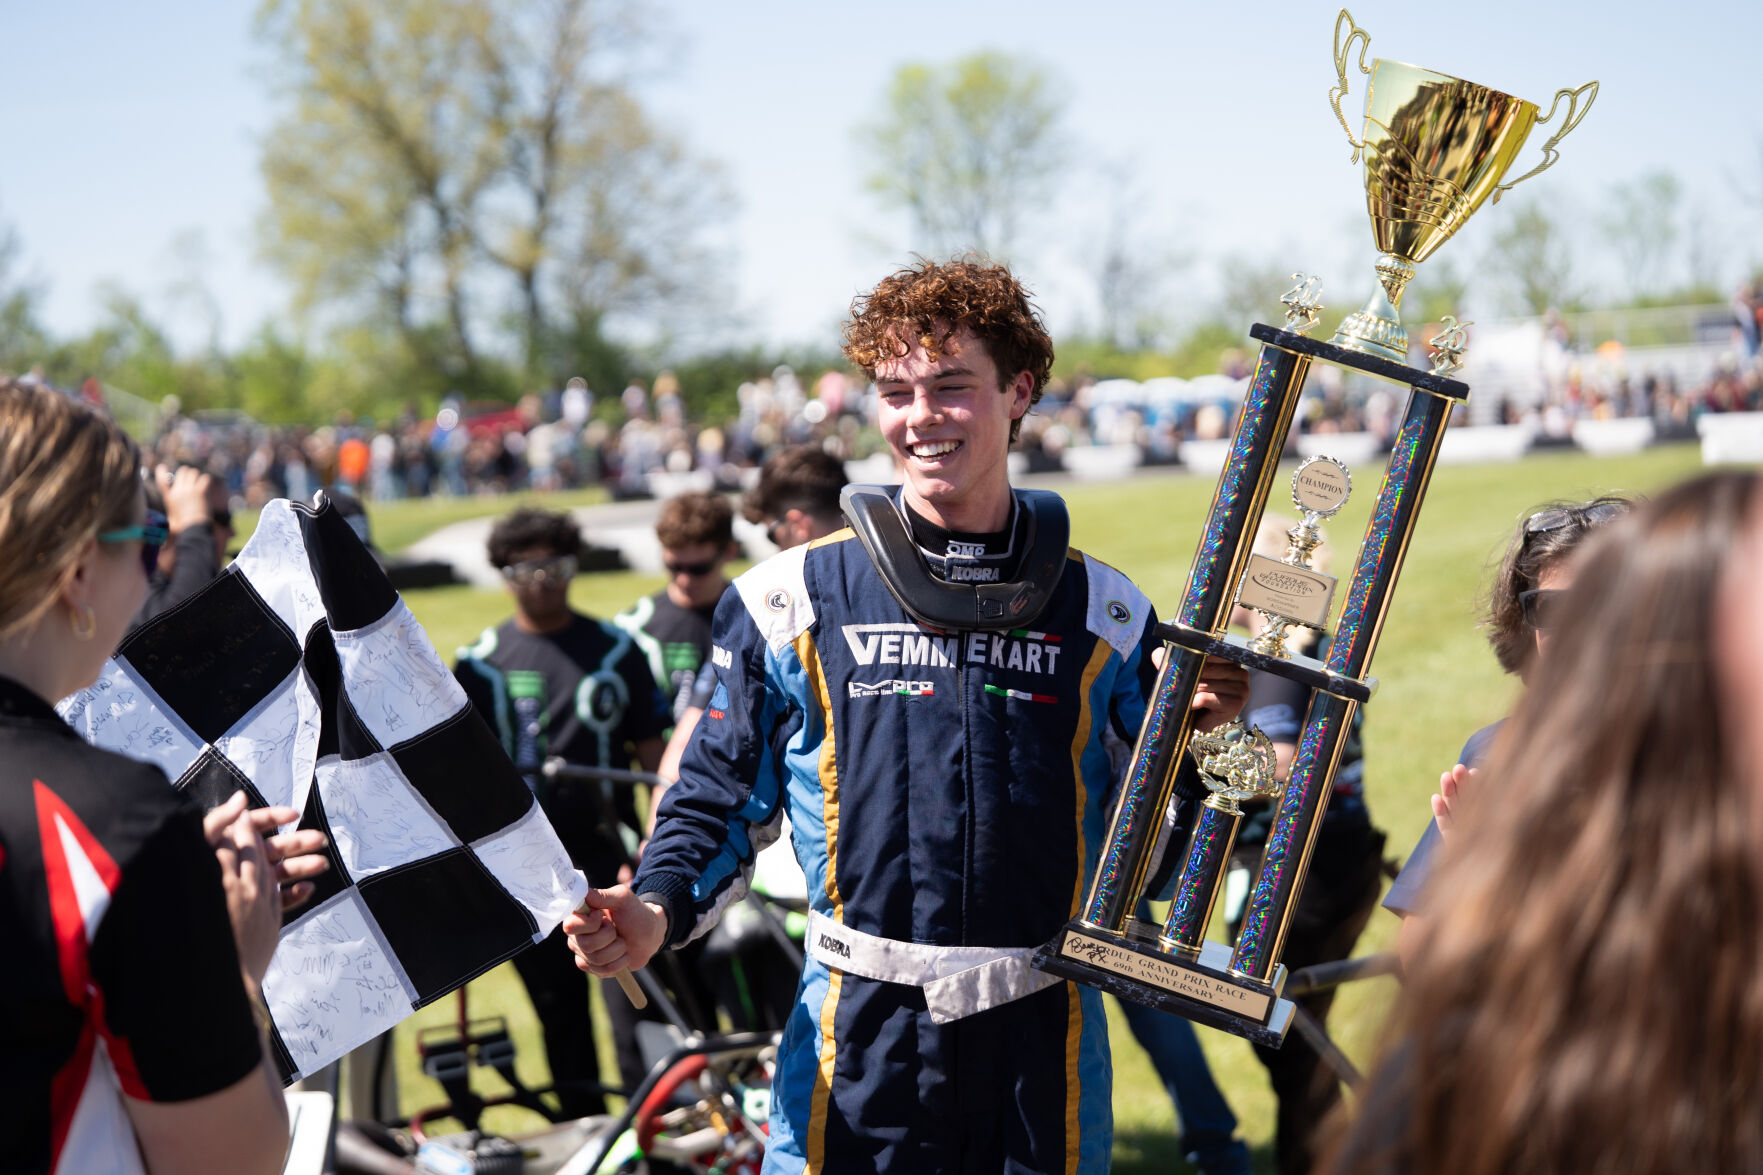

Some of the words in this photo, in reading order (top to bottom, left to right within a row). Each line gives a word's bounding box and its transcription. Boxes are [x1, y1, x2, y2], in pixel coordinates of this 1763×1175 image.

[1300, 476, 1343, 495] CHAMPION
[946, 540, 985, 556] OMP
[951, 566, 1000, 581] KOBRA
[818, 934, 851, 959] KOBRA
[1113, 961, 1133, 974] 69th
[1139, 970, 1215, 1000] ANNIVERSARY
[1138, 958, 1179, 977] GRAND
[1184, 973, 1210, 989] PRIX
[1216, 983, 1247, 1001] RACE
